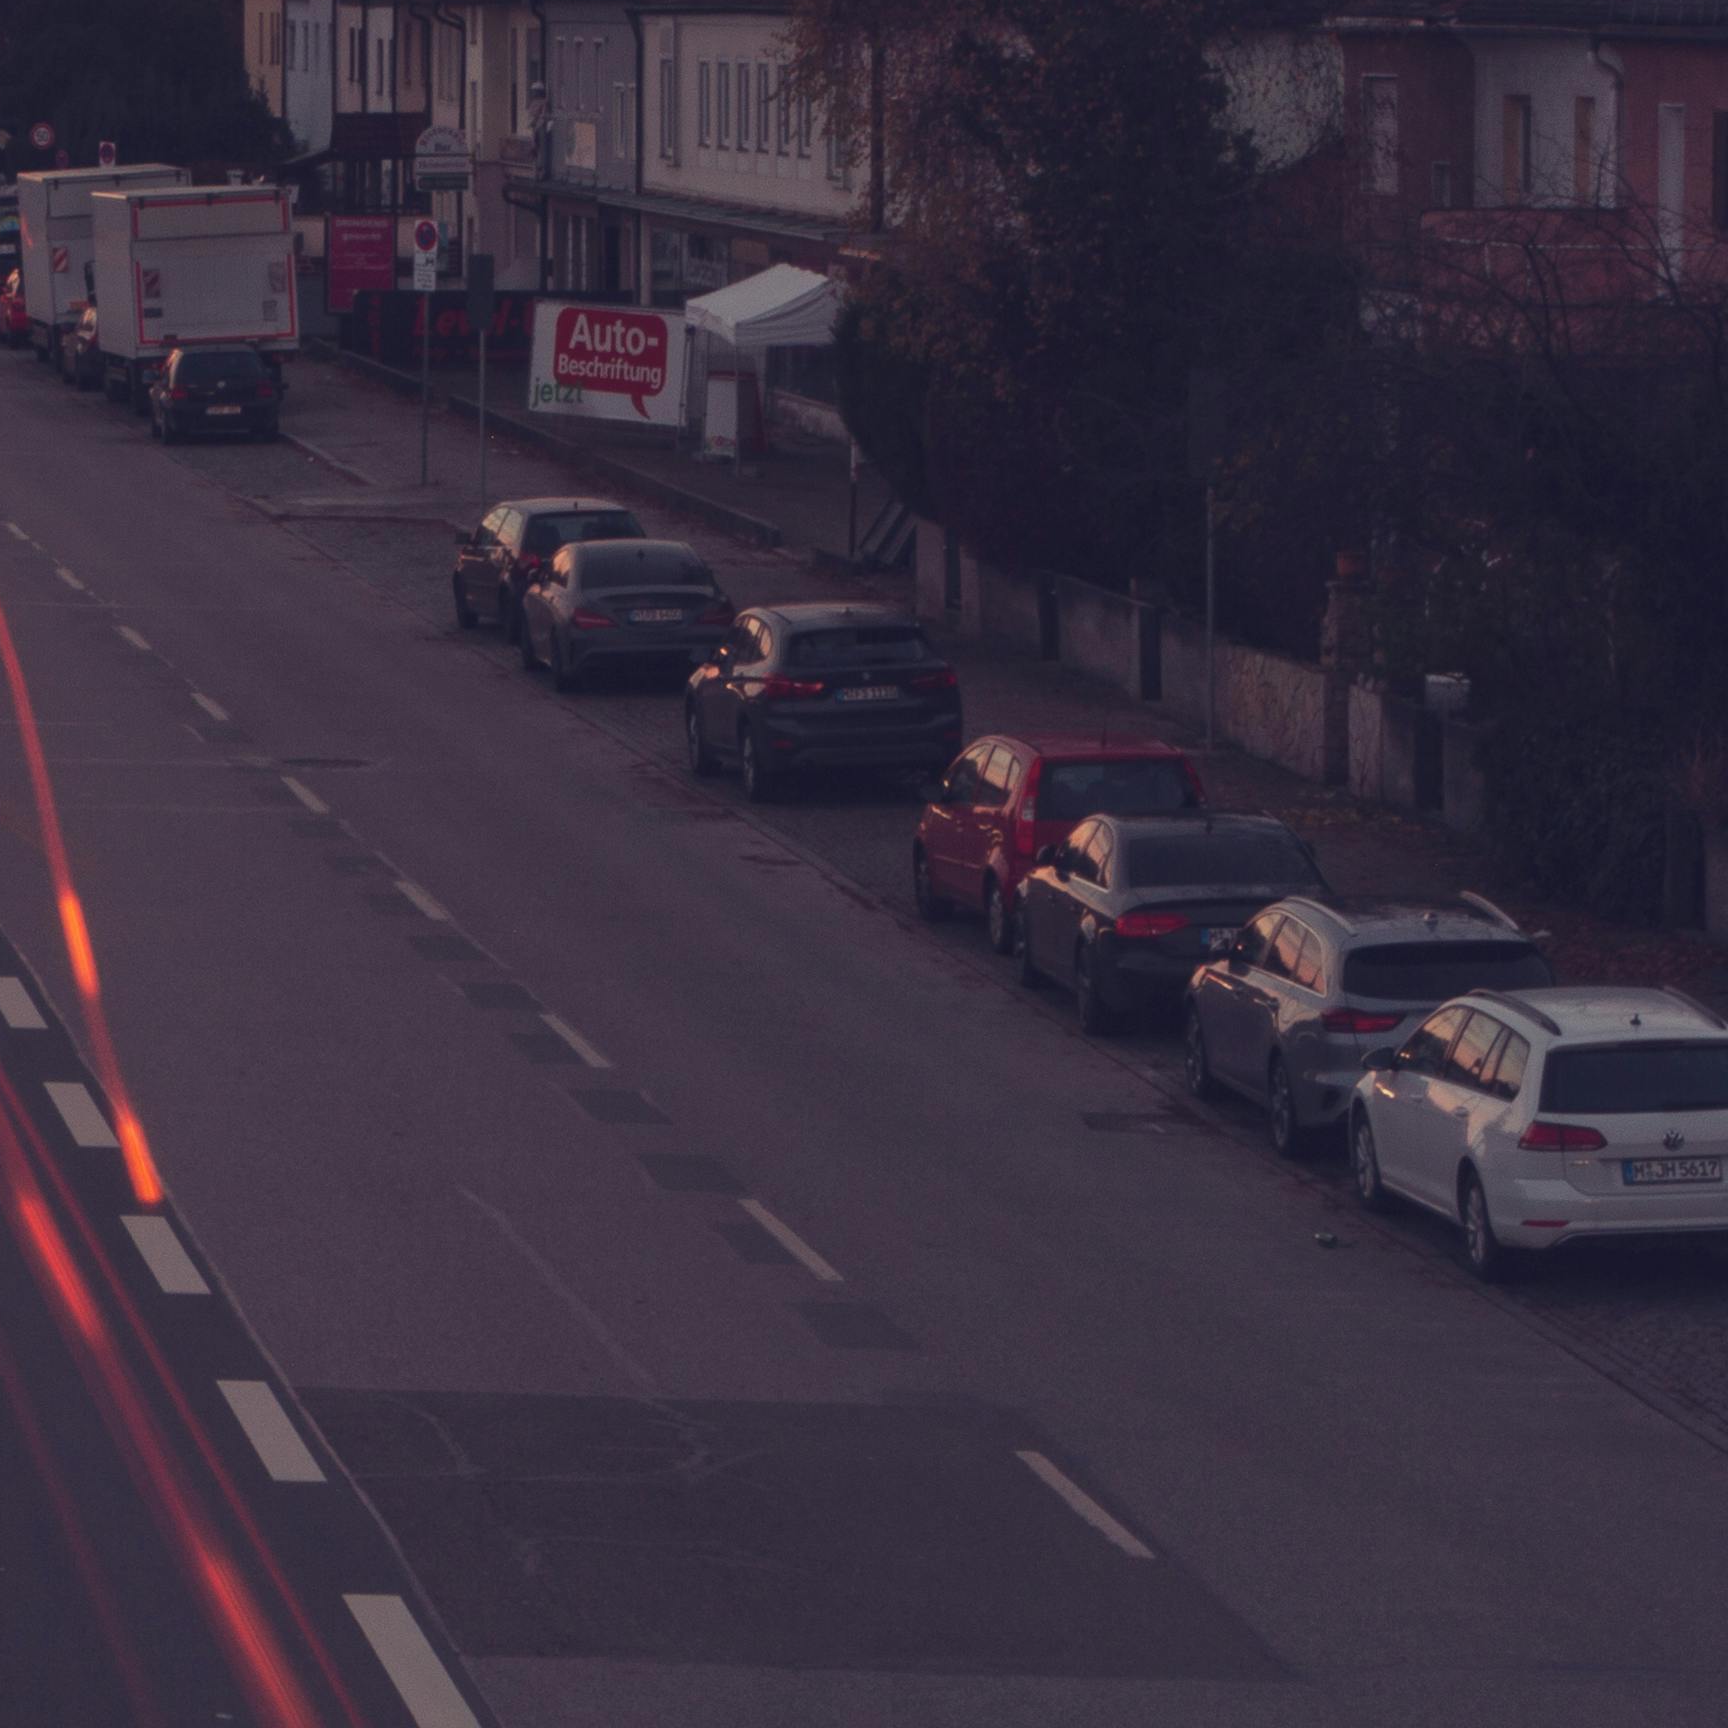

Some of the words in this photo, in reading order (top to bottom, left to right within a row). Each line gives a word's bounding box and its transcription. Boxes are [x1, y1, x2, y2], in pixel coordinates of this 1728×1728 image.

[569, 313, 659, 356] Auto-
[558, 353, 662, 389] Beschriftung
[531, 377, 584, 407] jetzt
